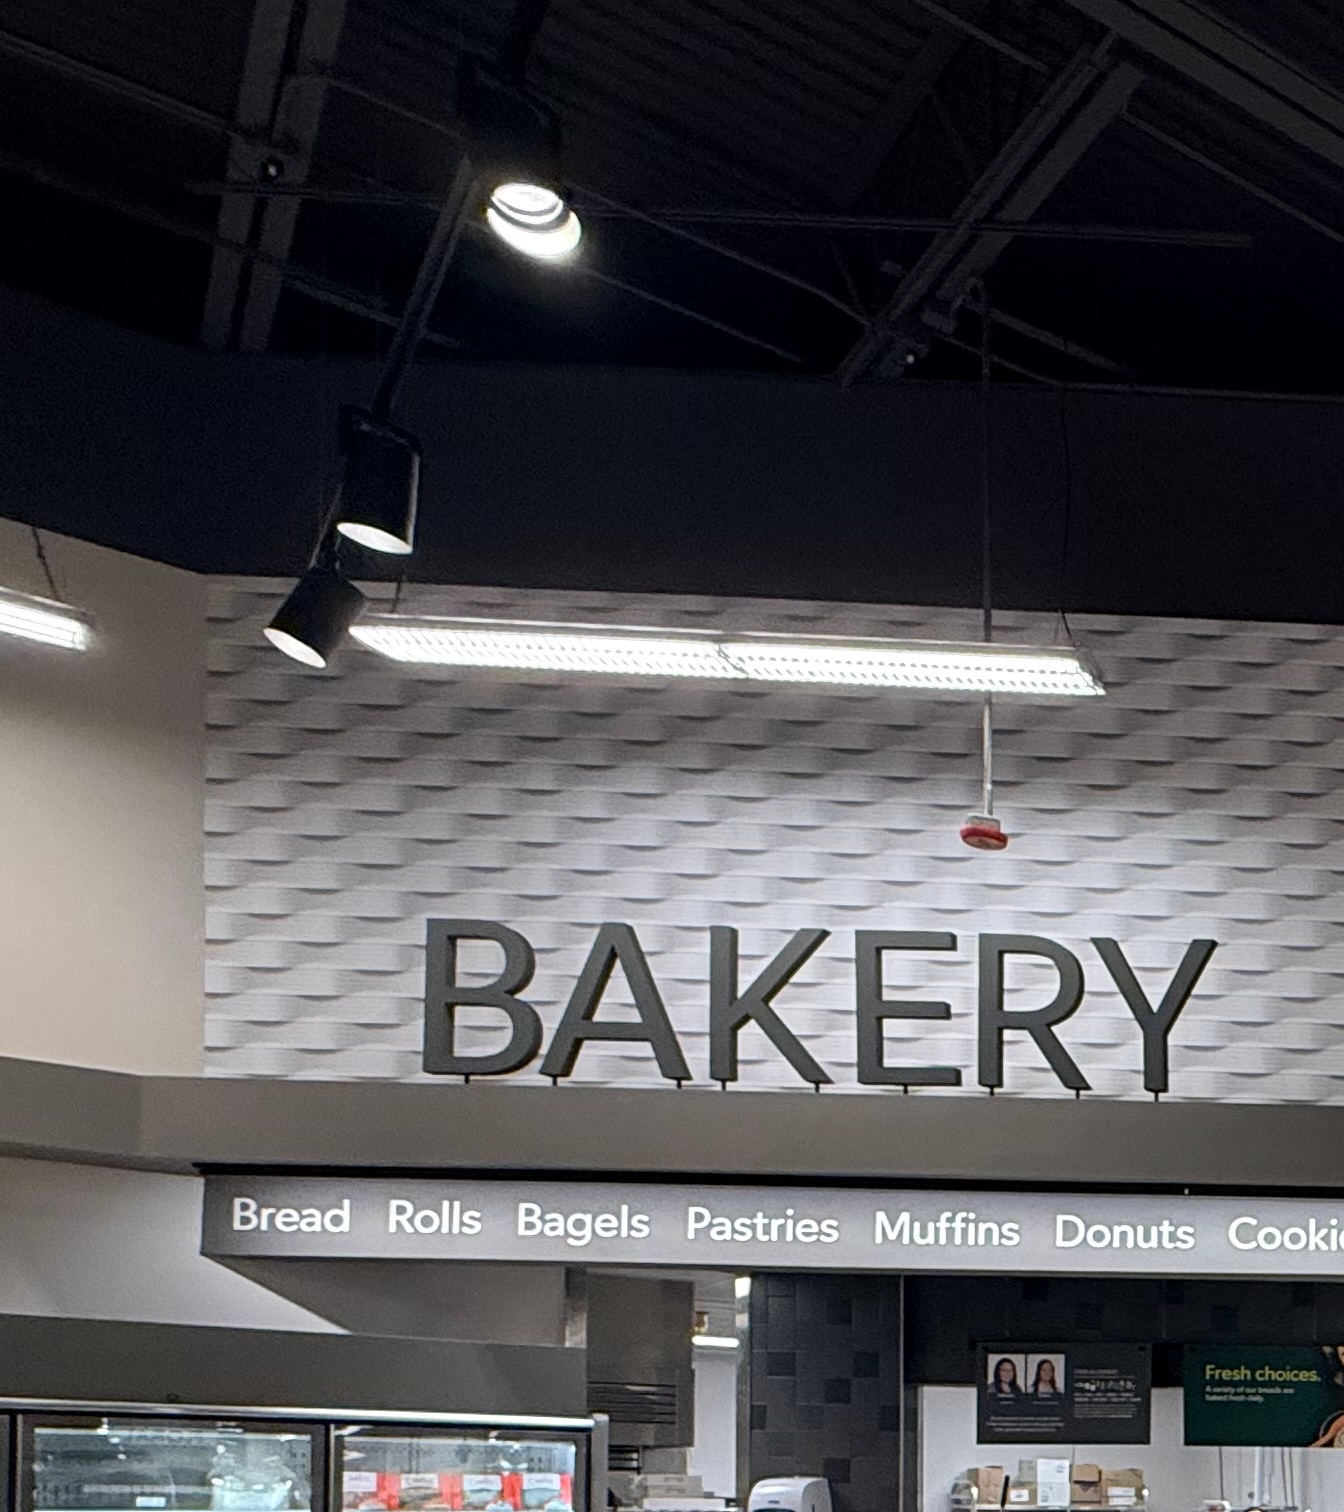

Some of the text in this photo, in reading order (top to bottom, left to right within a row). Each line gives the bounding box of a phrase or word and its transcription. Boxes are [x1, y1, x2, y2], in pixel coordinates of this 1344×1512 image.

[422, 918, 1218, 1096] BAKERY
[232, 1197, 352, 1234] Bread
[387, 1198, 483, 1236] Rolls
[516, 1201, 651, 1247] Bagels
[686, 1205, 841, 1244] Pastries
[873, 1209, 1021, 1247] Muffins
[1054, 1213, 1196, 1250] Donuts
[1205, 1364, 1322, 1382] Fresh choices.
